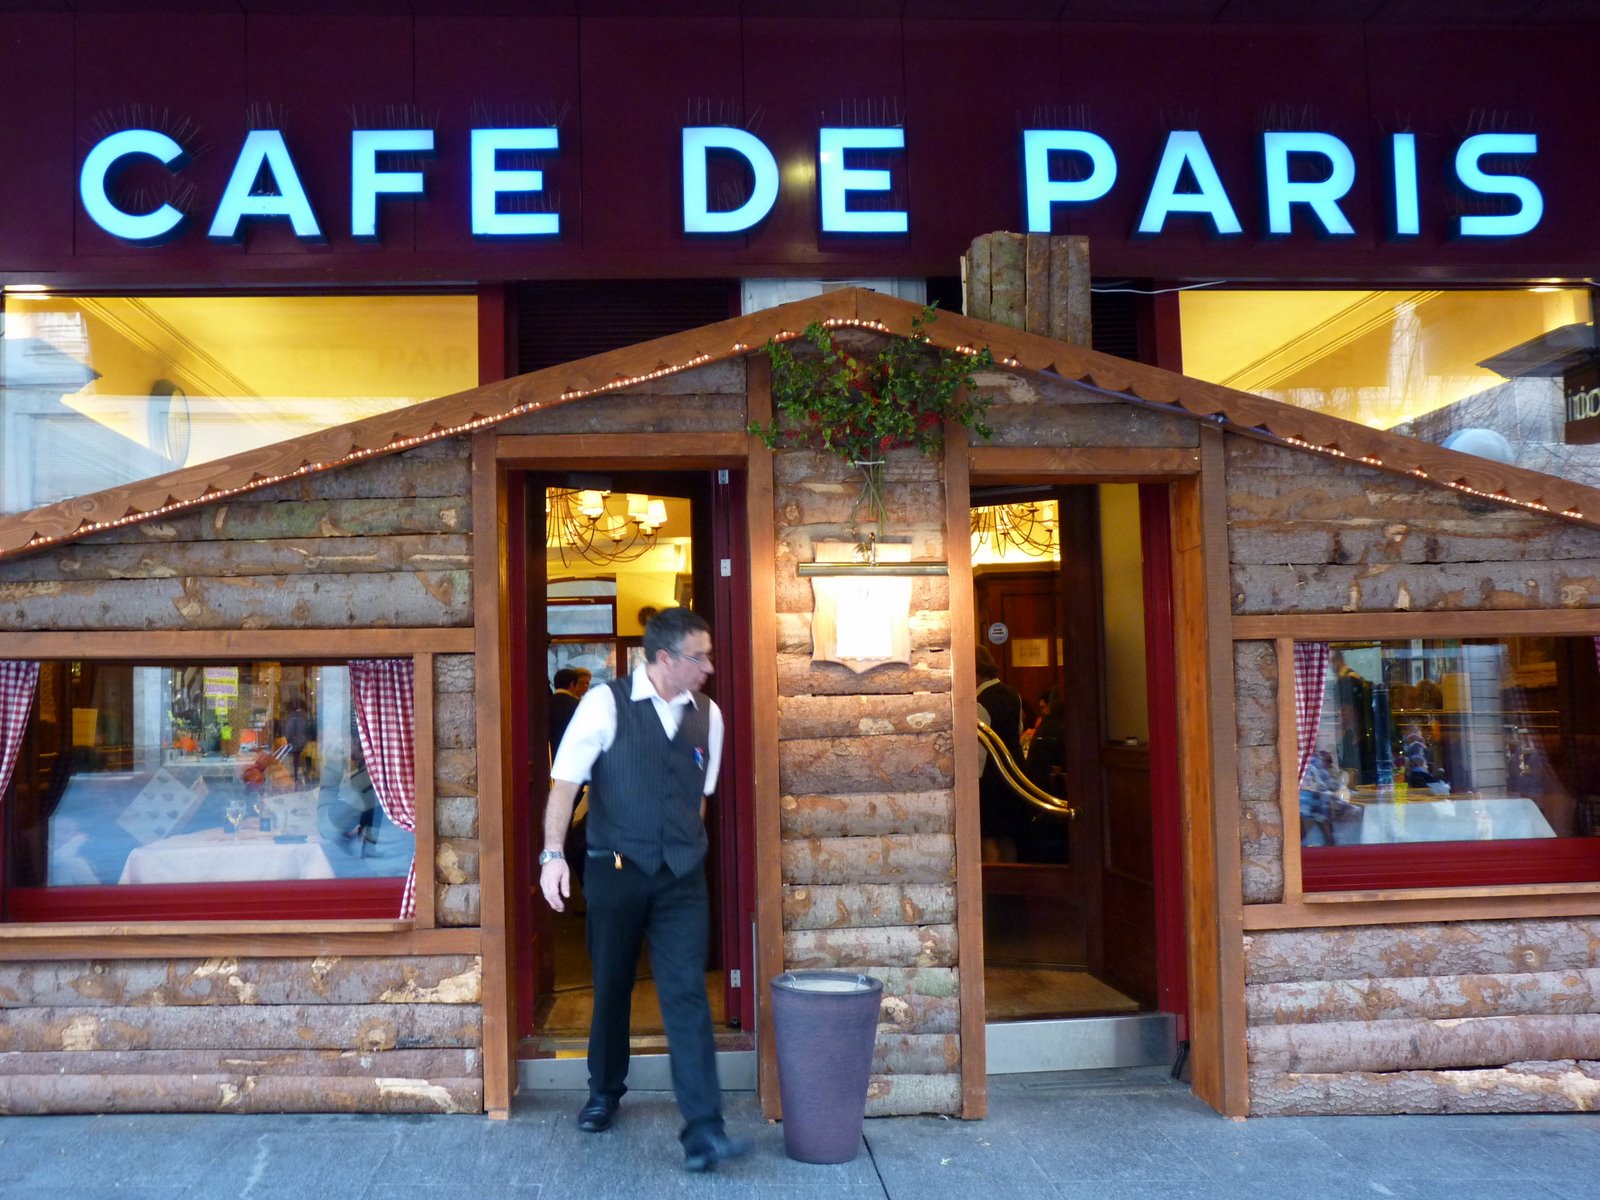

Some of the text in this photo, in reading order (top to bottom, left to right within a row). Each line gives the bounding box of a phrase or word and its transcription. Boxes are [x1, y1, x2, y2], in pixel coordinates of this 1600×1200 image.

[80, 127, 1545, 241] CAFE DE PARIS
